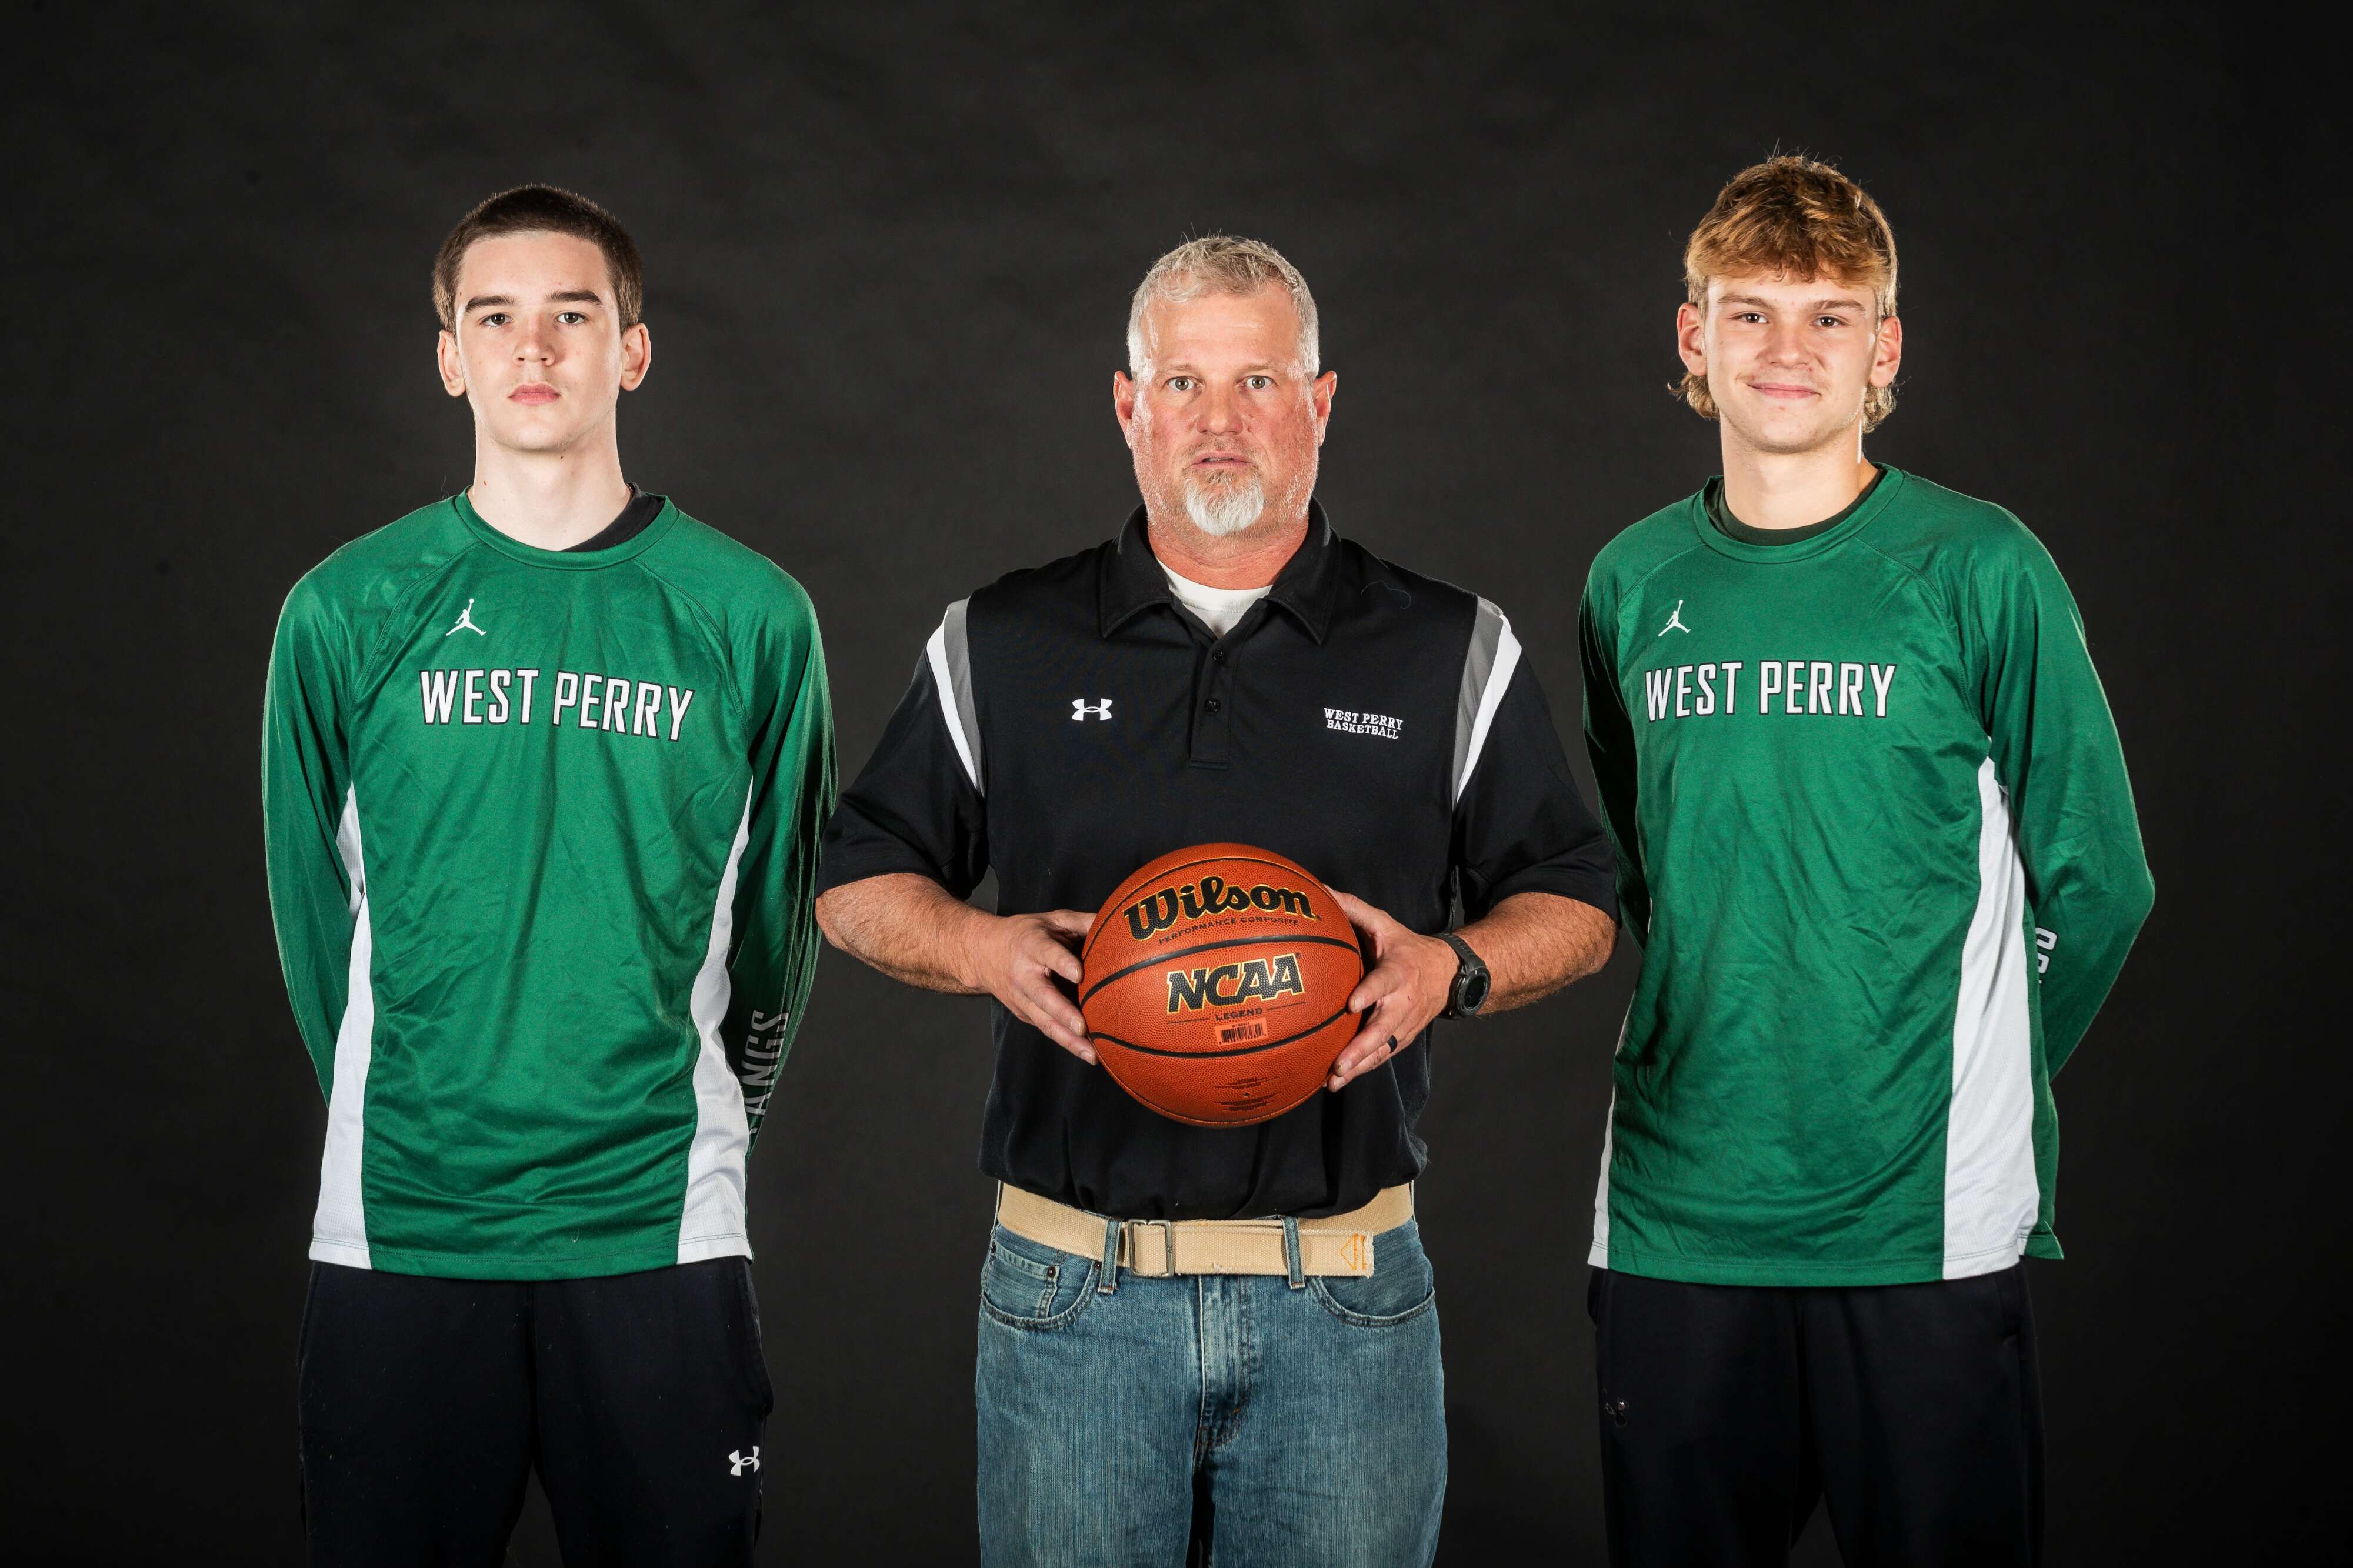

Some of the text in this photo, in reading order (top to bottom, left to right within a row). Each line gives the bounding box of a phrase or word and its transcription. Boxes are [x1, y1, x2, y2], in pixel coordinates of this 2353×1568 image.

[419, 668, 696, 742] WEST PERRY
[1324, 708, 1404, 730] WEST PERRY
[1645, 660, 1897, 723] WEST PERRY
[1327, 719, 1398, 739] BASKETBALL
[1124, 875, 1317, 941] Wilson
[1158, 916, 1300, 945] PERFORMANCE COMPOSITE
[1167, 952, 1305, 1015] NCAA
[1215, 1007, 1263, 1022] LEGEND
[739, 1009, 789, 1134] ANGS
